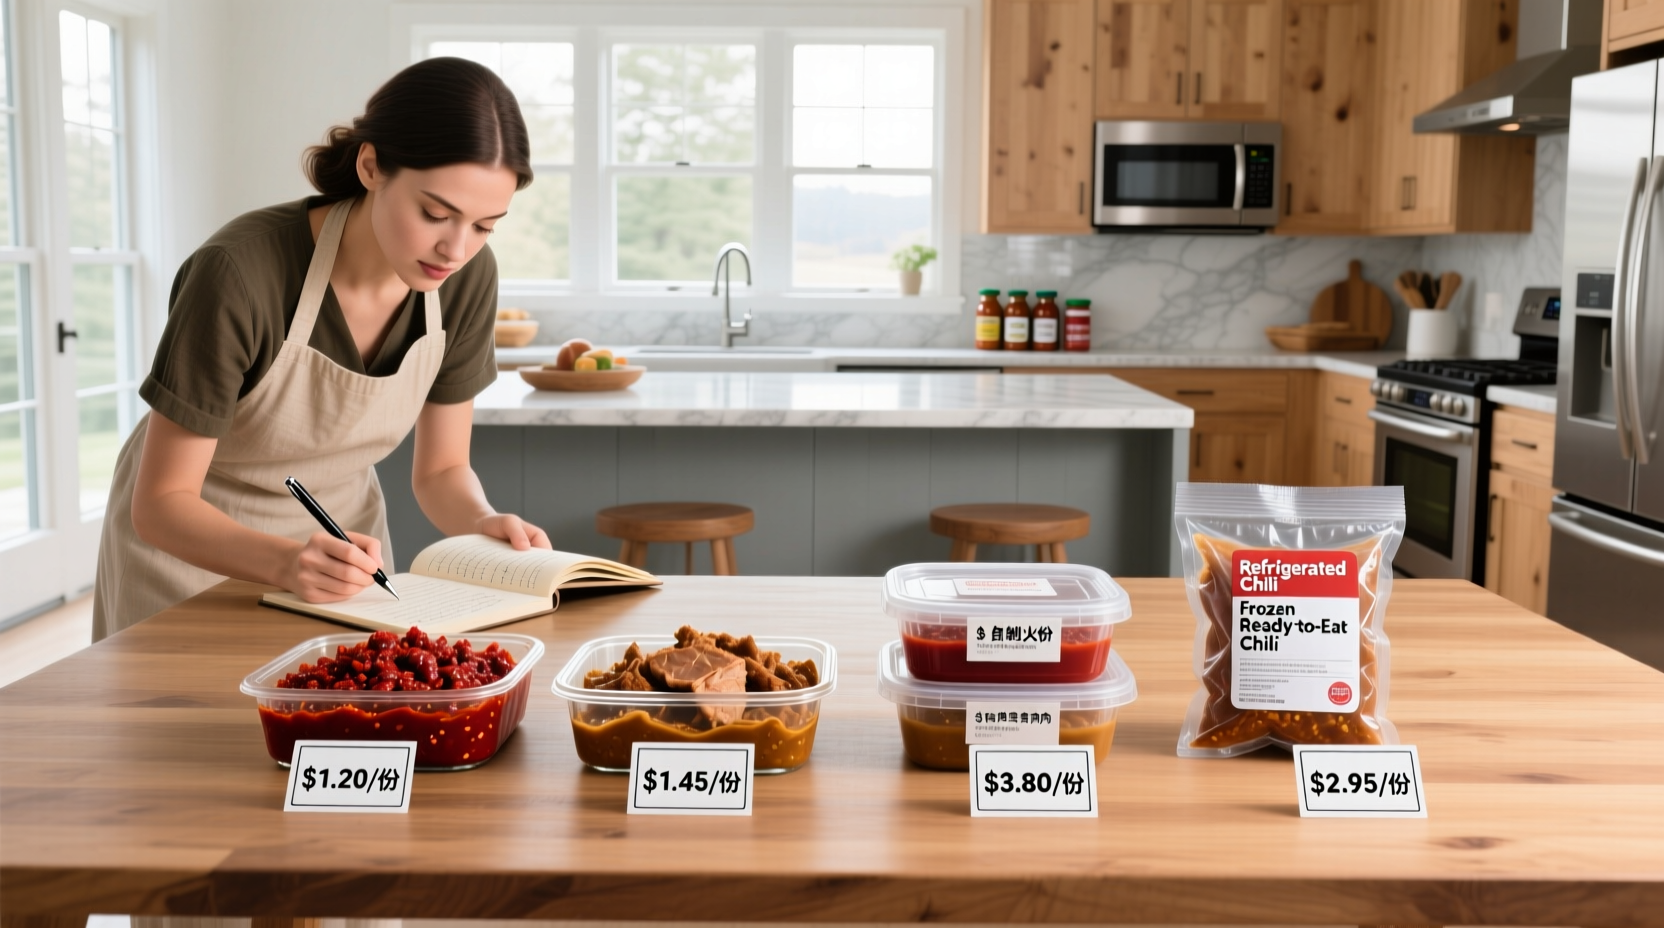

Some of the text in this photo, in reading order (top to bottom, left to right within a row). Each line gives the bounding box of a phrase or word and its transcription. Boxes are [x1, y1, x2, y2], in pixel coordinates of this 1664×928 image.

[1239, 558, 1347, 580] Refrigerated
[1239, 575, 1279, 592] Chili
[1239, 617, 1348, 637] Ready-to-Eat
[1239, 635, 1280, 652] Chili
[301, 765, 400, 794] $1.20/份
[642, 767, 742, 796] $1.45/份
[984, 769, 1085, 797] $3.80/份
[1310, 769, 1411, 797] $2.95/份
